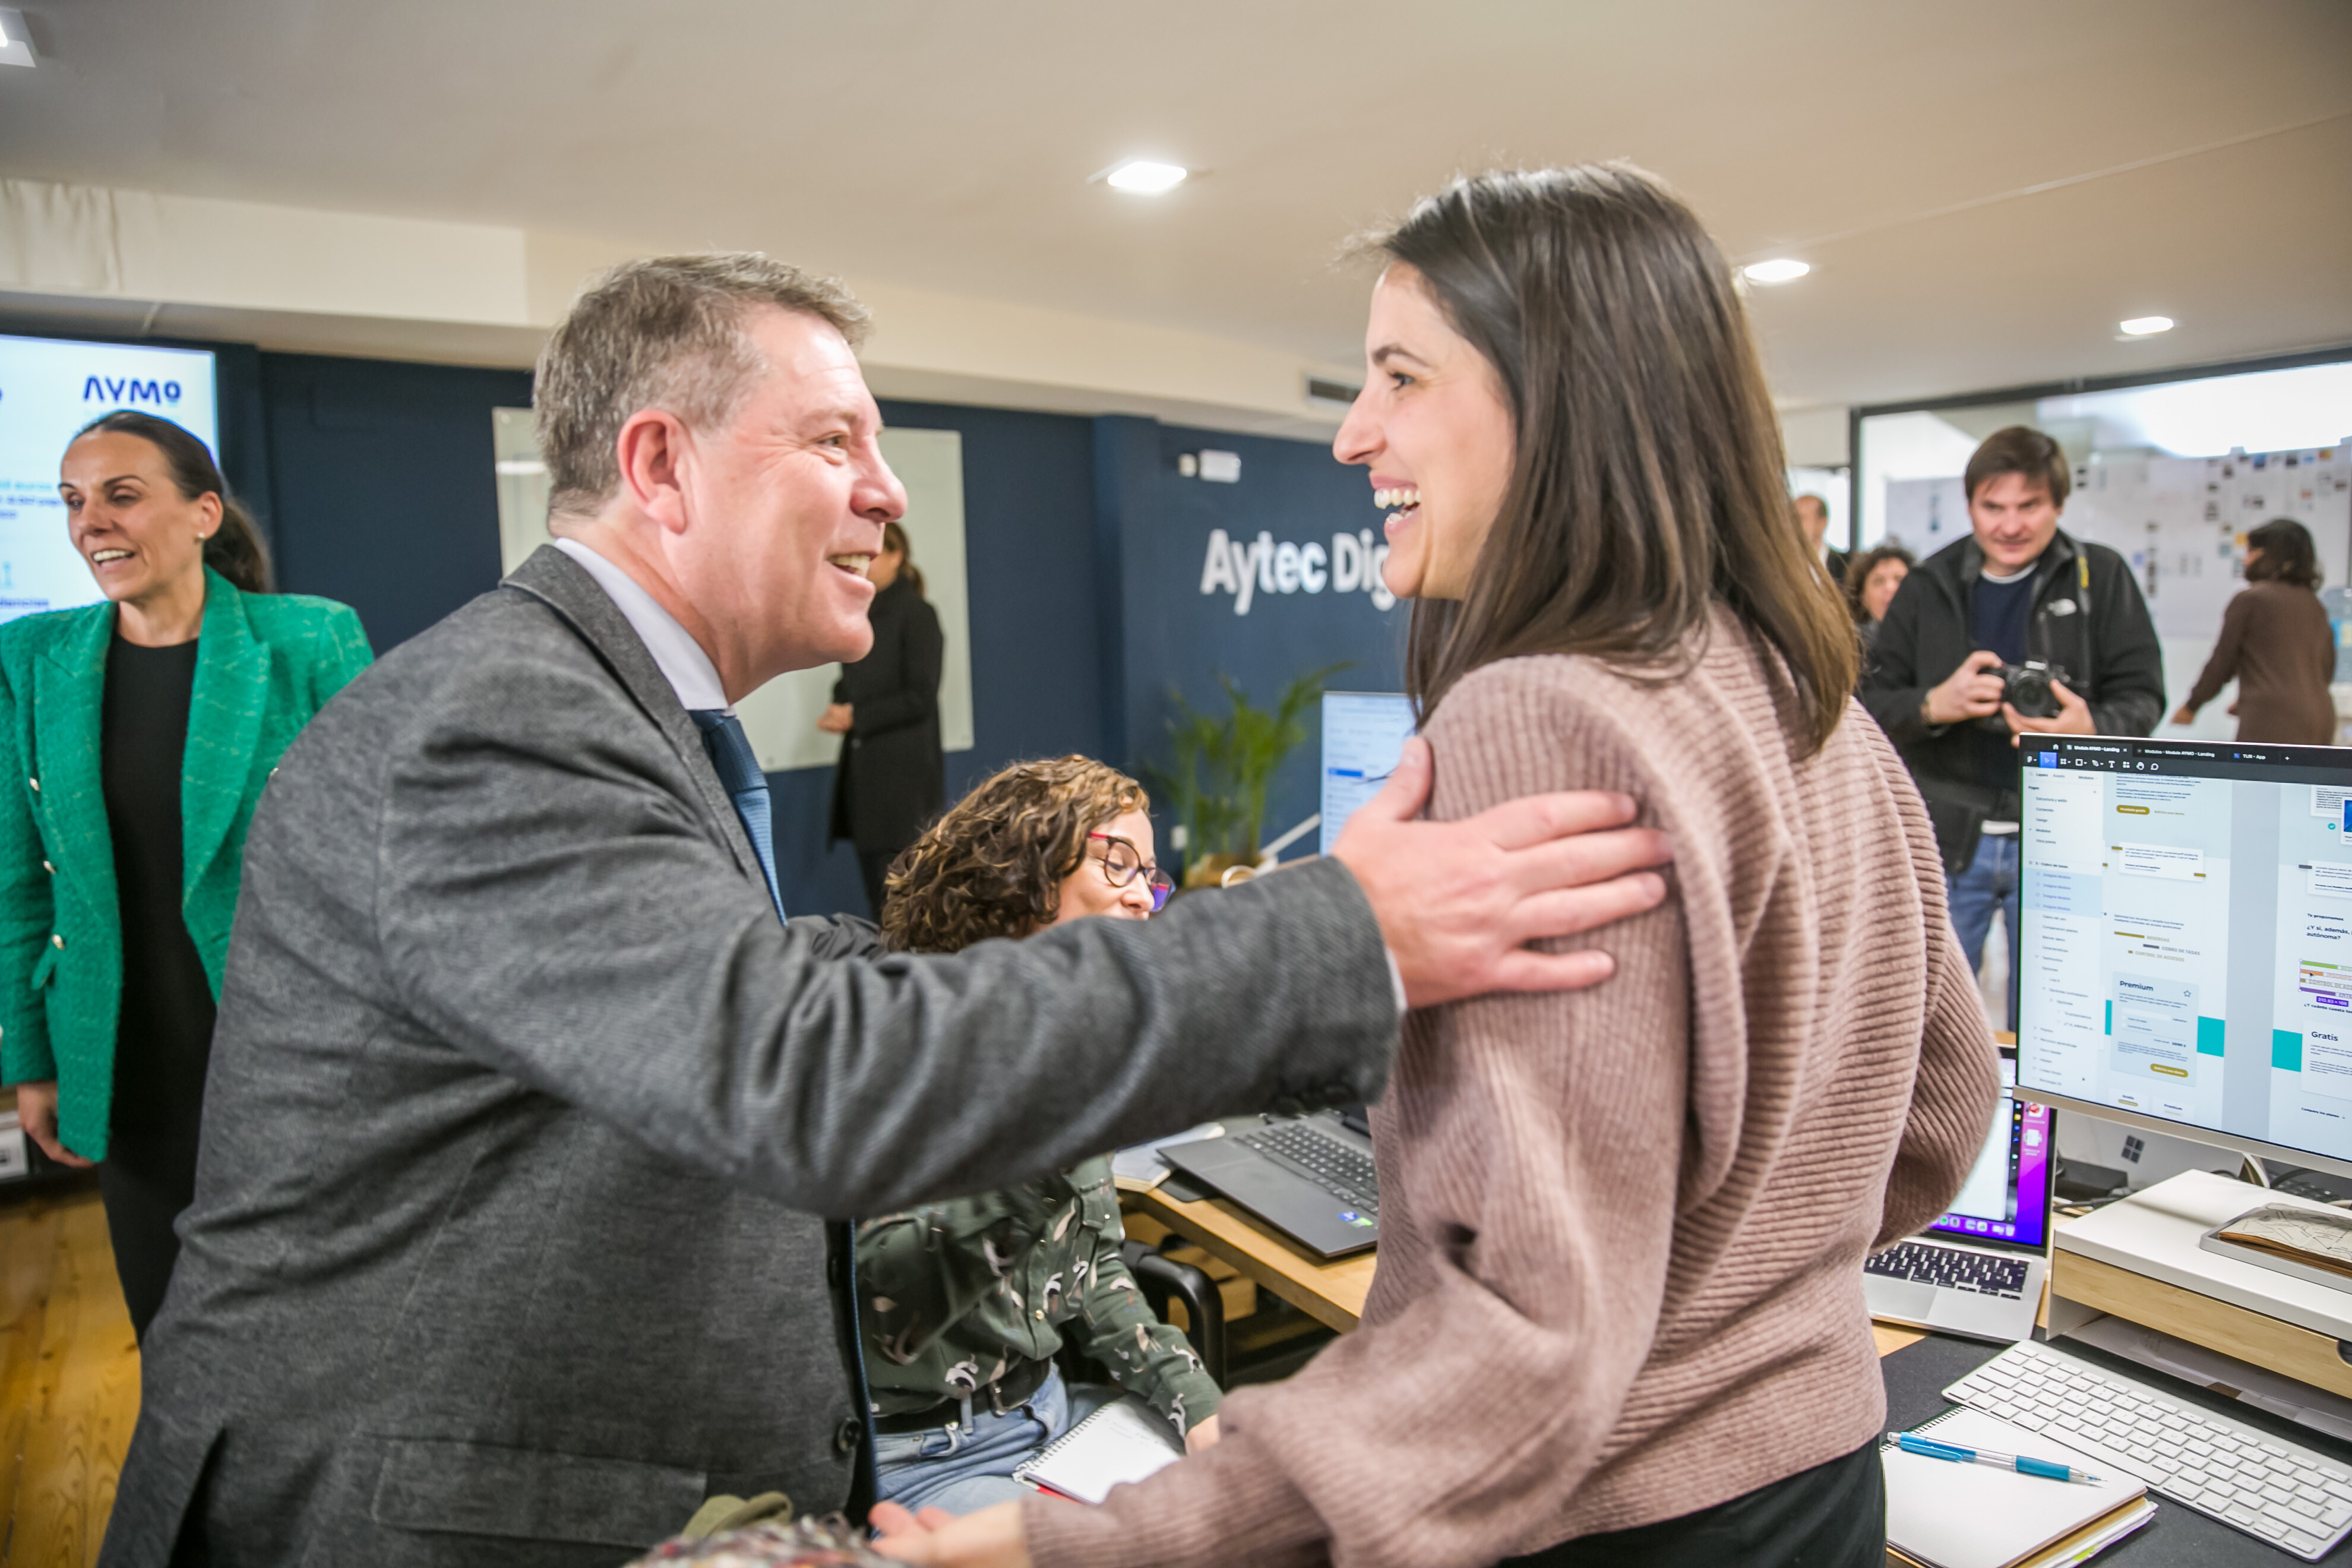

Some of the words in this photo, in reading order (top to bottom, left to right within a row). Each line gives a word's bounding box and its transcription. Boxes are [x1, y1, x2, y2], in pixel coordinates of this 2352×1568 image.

[1200, 528, 1328, 616] Aytec
[2119, 981, 2154, 991] Premium
[2311, 1031, 2339, 1042] Gratis
